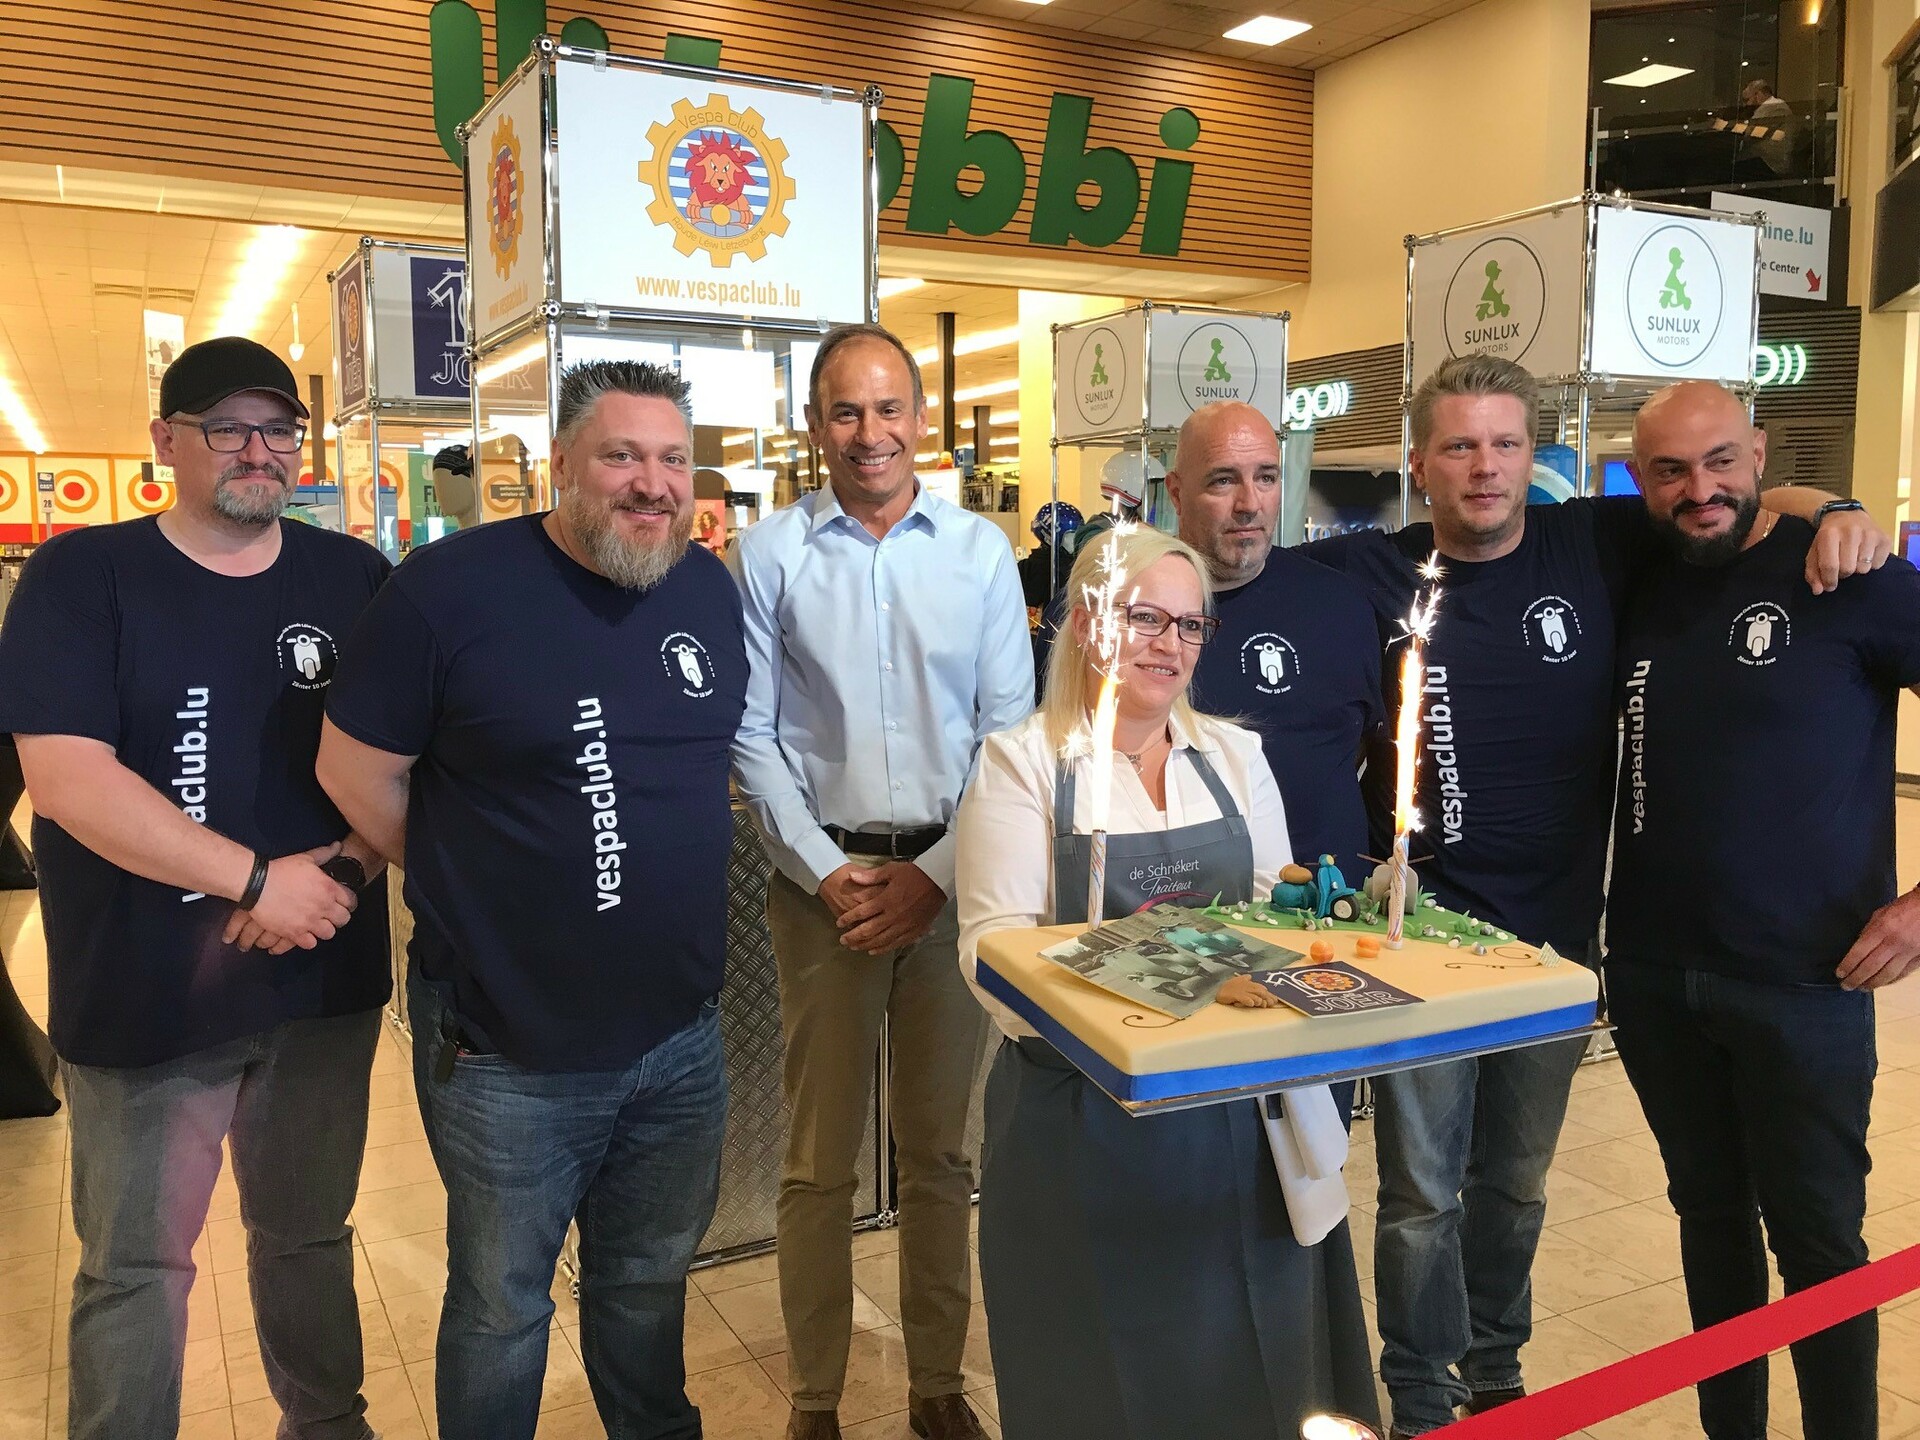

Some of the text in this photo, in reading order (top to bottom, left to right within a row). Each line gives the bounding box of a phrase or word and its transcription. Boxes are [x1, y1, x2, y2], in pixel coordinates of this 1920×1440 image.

[678, 111, 759, 139] Vespa Club
[1769, 261, 1800, 274] Center
[636, 276, 801, 307] www.vespaclub.lu
[1464, 323, 1520, 345] SUNLUX
[1647, 315, 1701, 334] SUNLUX
[1474, 342, 1509, 355] MOTORS
[1656, 335, 1691, 346] MOTORS
[1085, 389, 1114, 404] SUNLUX
[1195, 386, 1240, 399] SUNLUX
[43, 499, 53, 508] 28
[1422, 665, 1468, 845] vespaclub.lu
[1626, 660, 1652, 835] vespaclub.lu
[171, 687, 209, 903] aclub.lu
[573, 697, 627, 912] vespaclub.lu
[1129, 859, 1200, 881] de Schnékert
[1140, 876, 1192, 898] Traiteur
[1262, 968, 1369, 998] 10
[1313, 990, 1404, 1012] JOER
